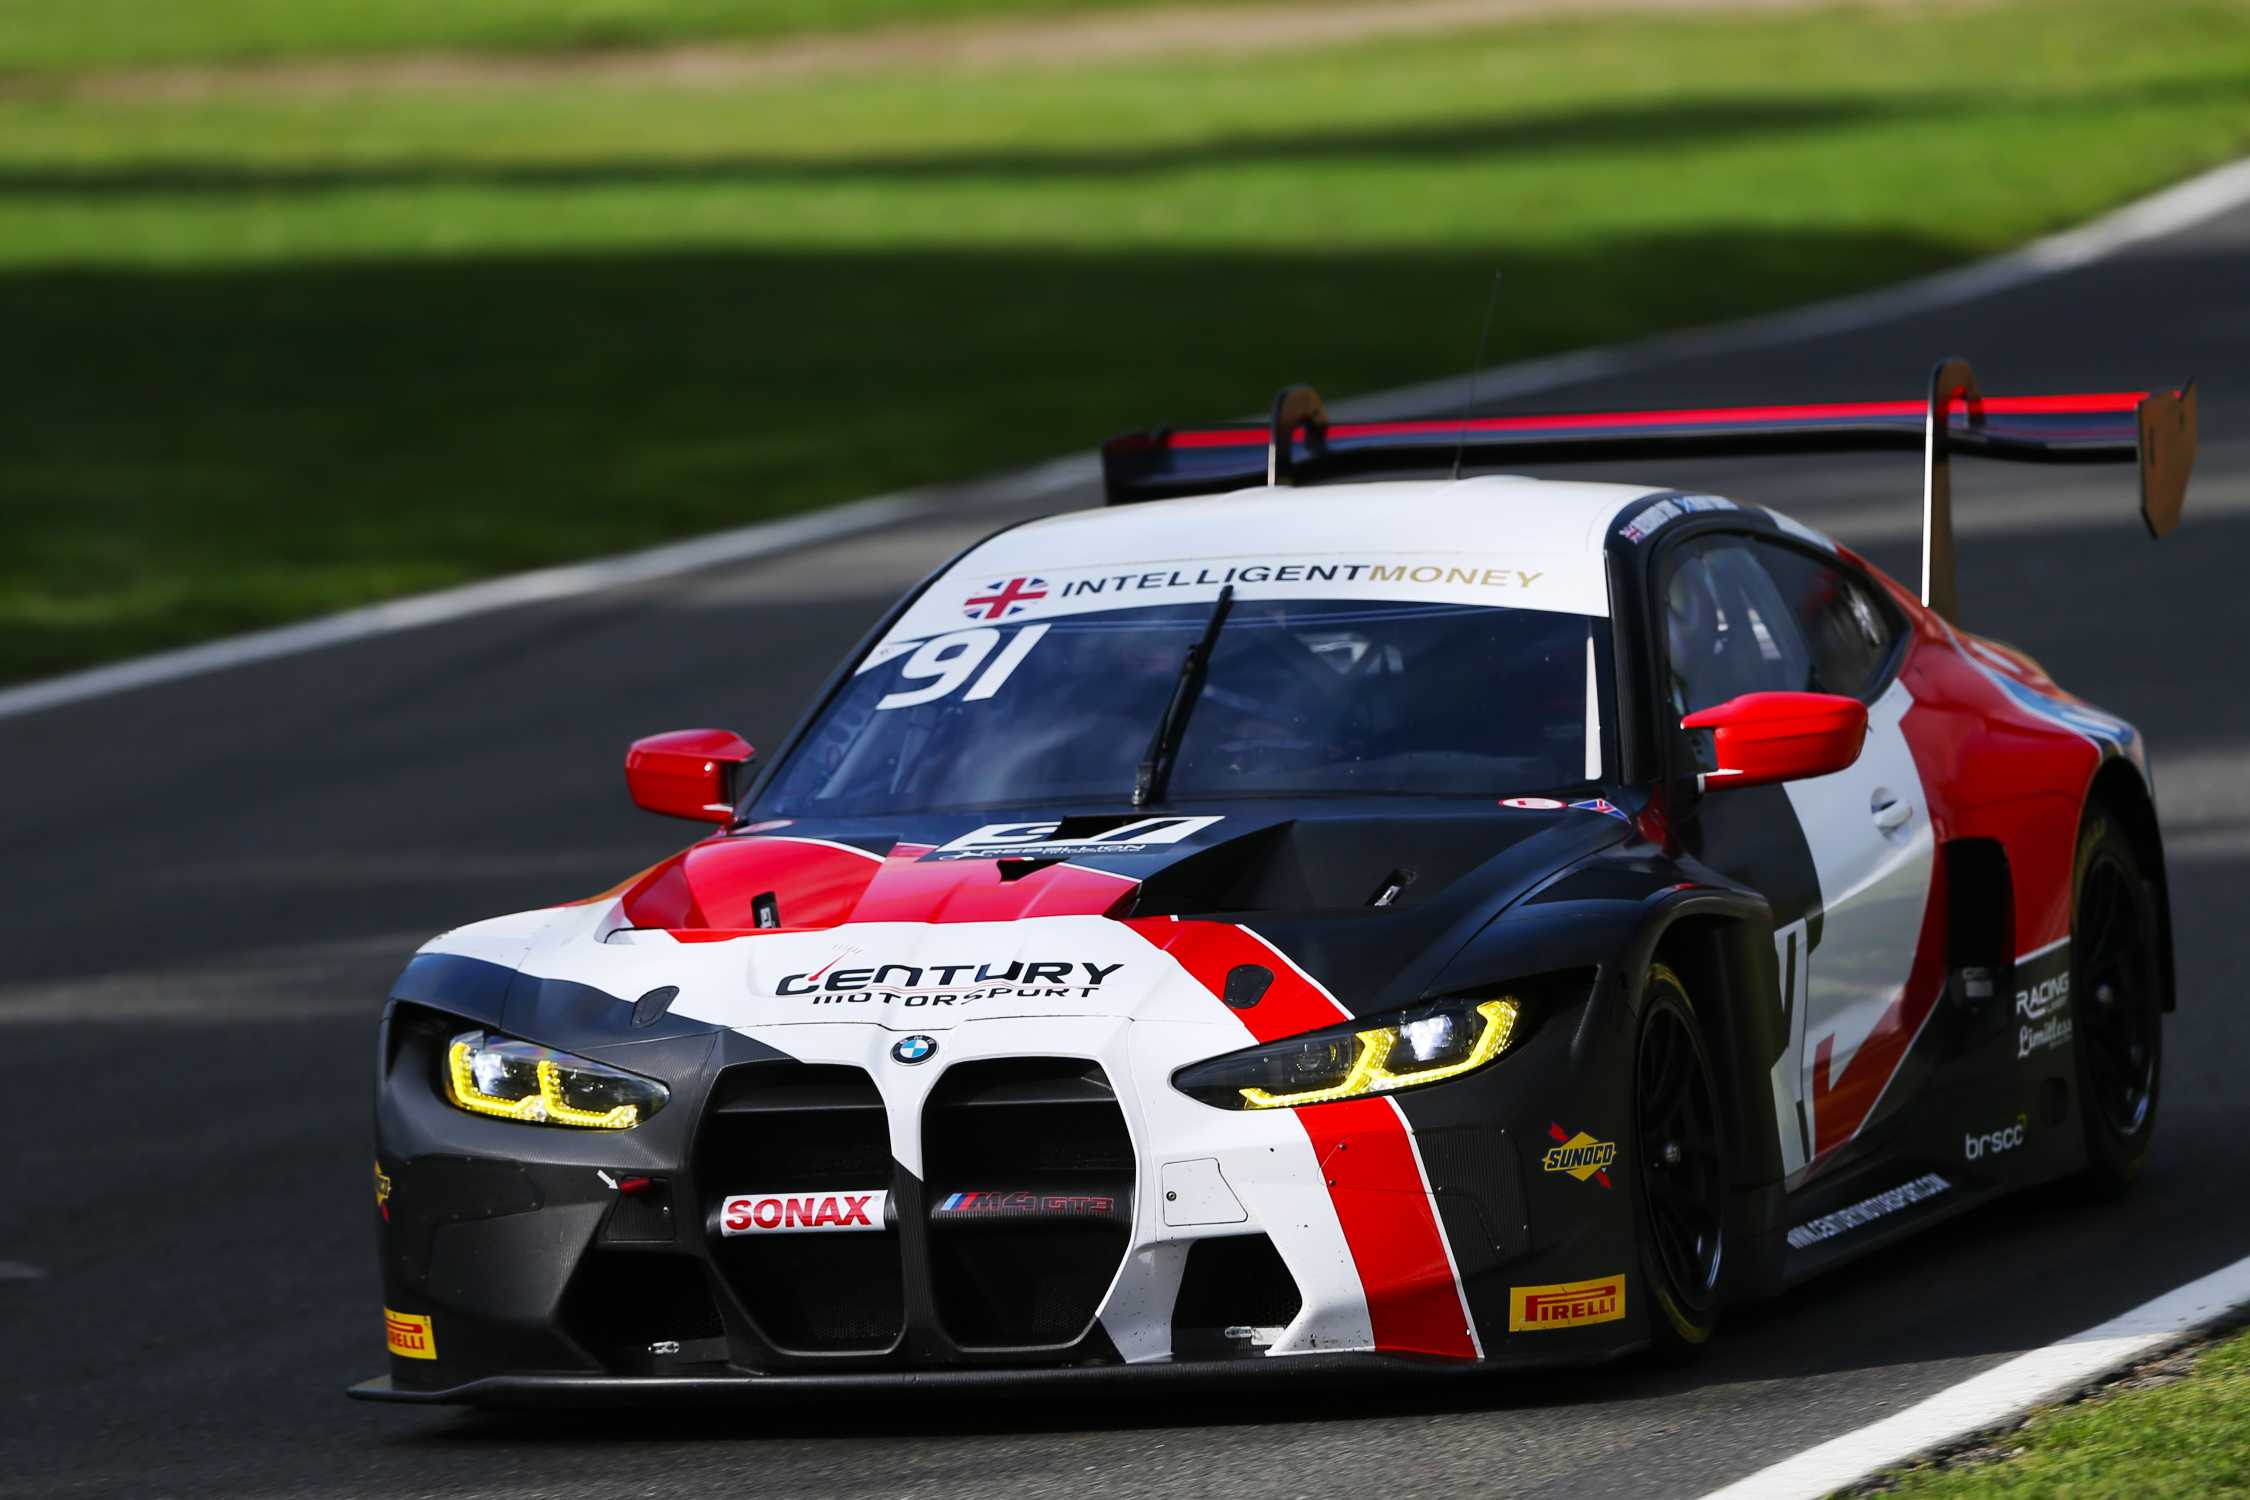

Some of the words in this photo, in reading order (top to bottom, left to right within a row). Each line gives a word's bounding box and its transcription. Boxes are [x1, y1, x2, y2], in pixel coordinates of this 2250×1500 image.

[876, 623, 1051, 710] 91
[774, 960, 1125, 996] CENTURY
[2015, 971, 2070, 1019] RACING
[812, 986, 1100, 1008] MOTORSPORT
[1547, 1142, 1615, 1170] SUNOCO
[1965, 1123, 2024, 1160] brscc
[725, 1194, 873, 1231] SONAX
[1525, 1284, 1617, 1322] PIRELLI
[386, 1318, 426, 1350] RELLI
